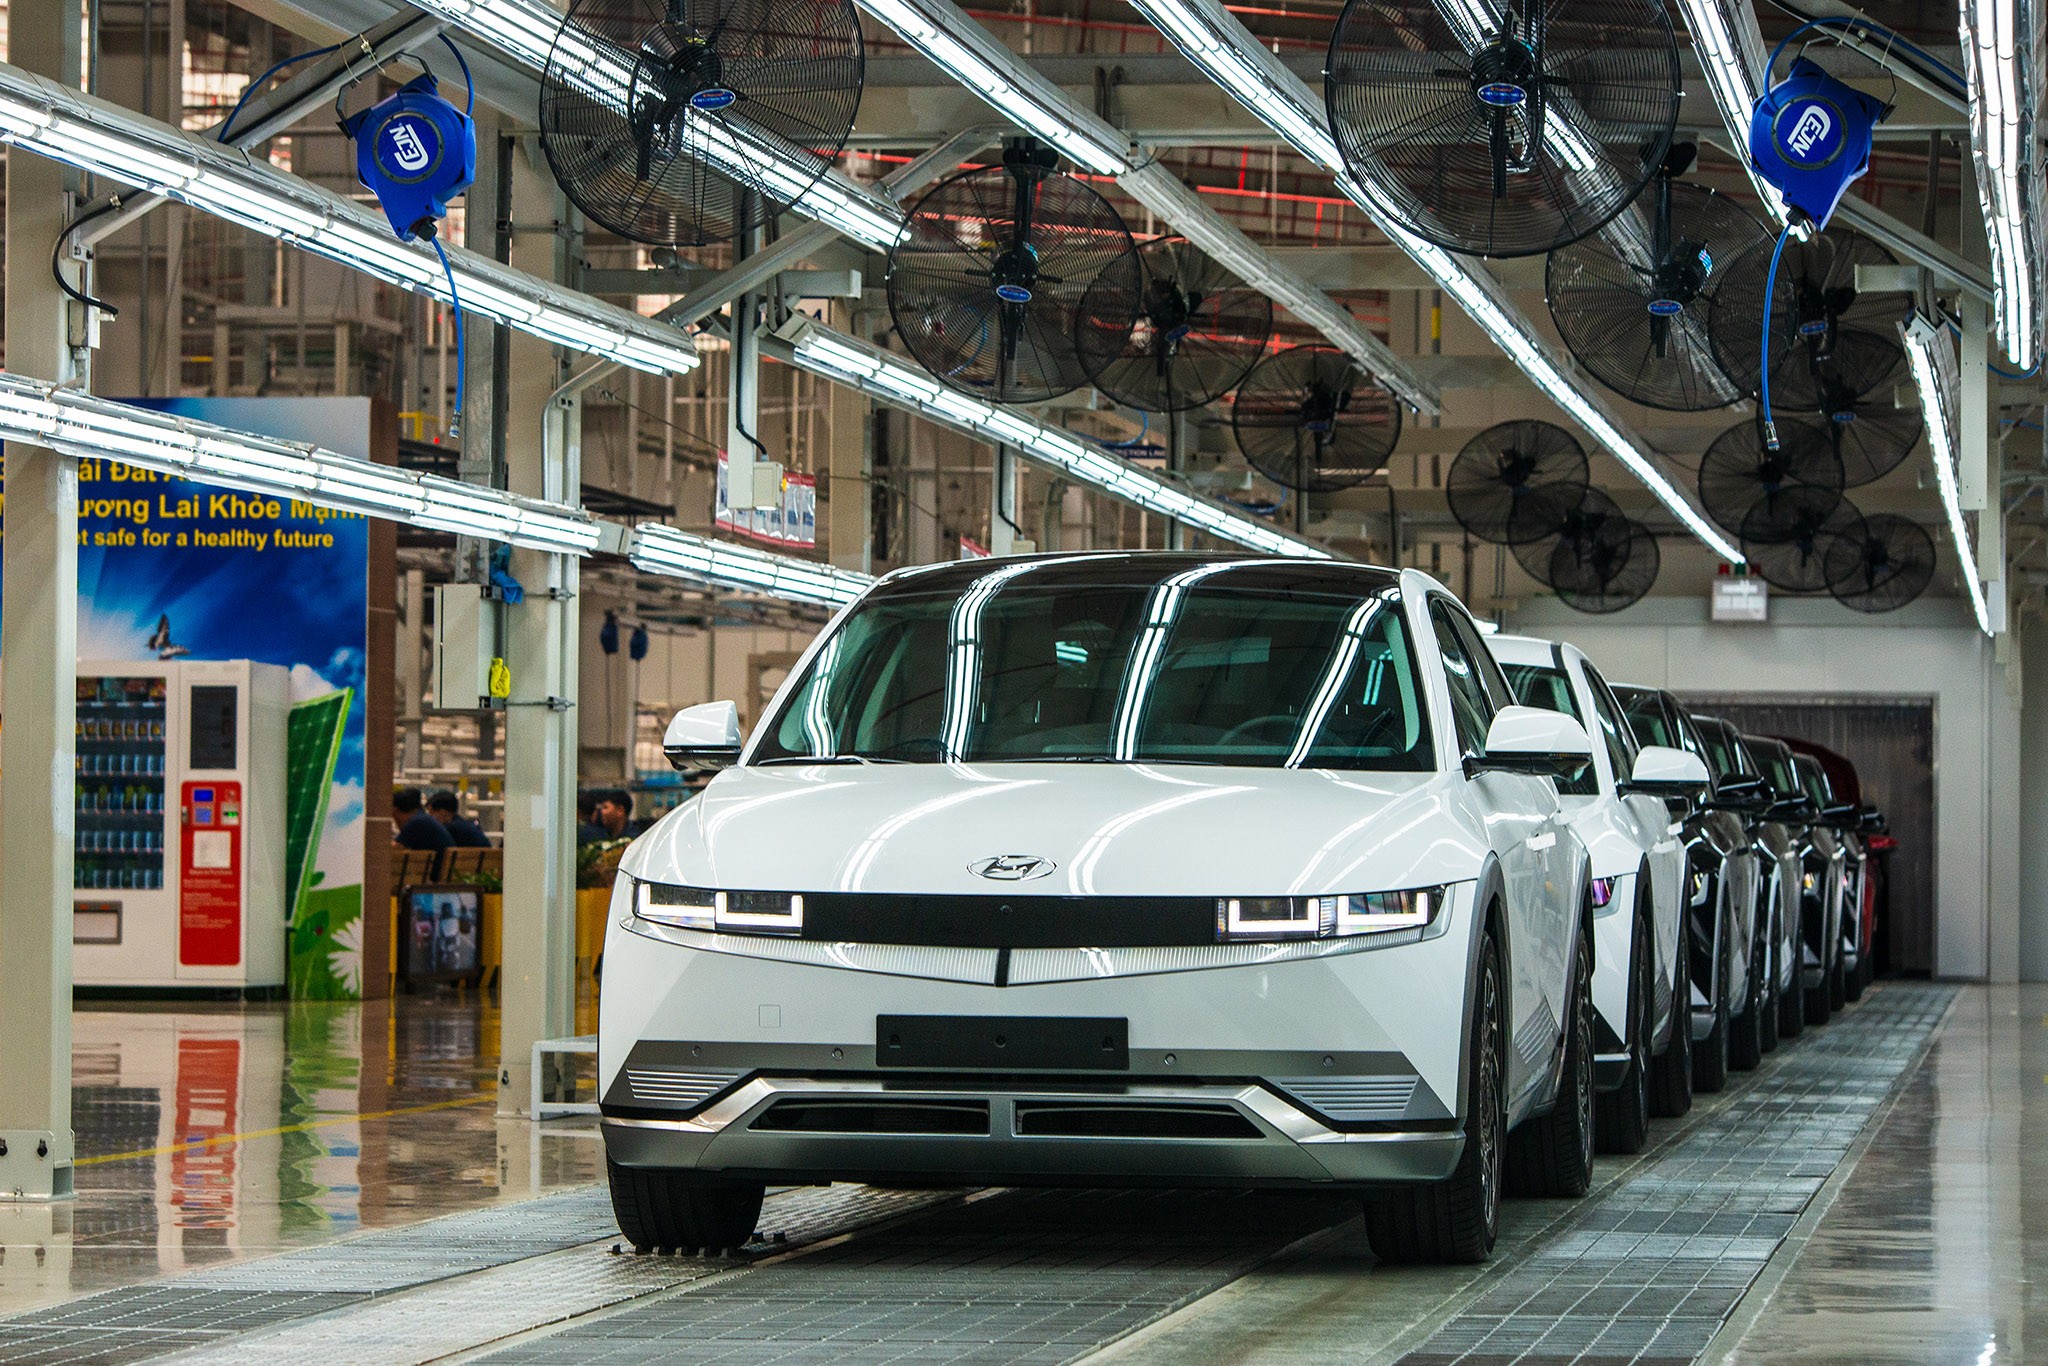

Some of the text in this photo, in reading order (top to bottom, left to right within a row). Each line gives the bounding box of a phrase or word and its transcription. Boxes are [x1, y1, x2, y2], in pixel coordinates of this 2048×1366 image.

[78, 499, 150, 525] ương
[159, 494, 200, 518] Lai
[209, 494, 281, 519] Khỏe
[94, 528, 136, 547] safe
[142, 528, 171, 547] for
[176, 532, 188, 547] a
[194, 528, 268, 552] healthy
[274, 528, 334, 547] future
